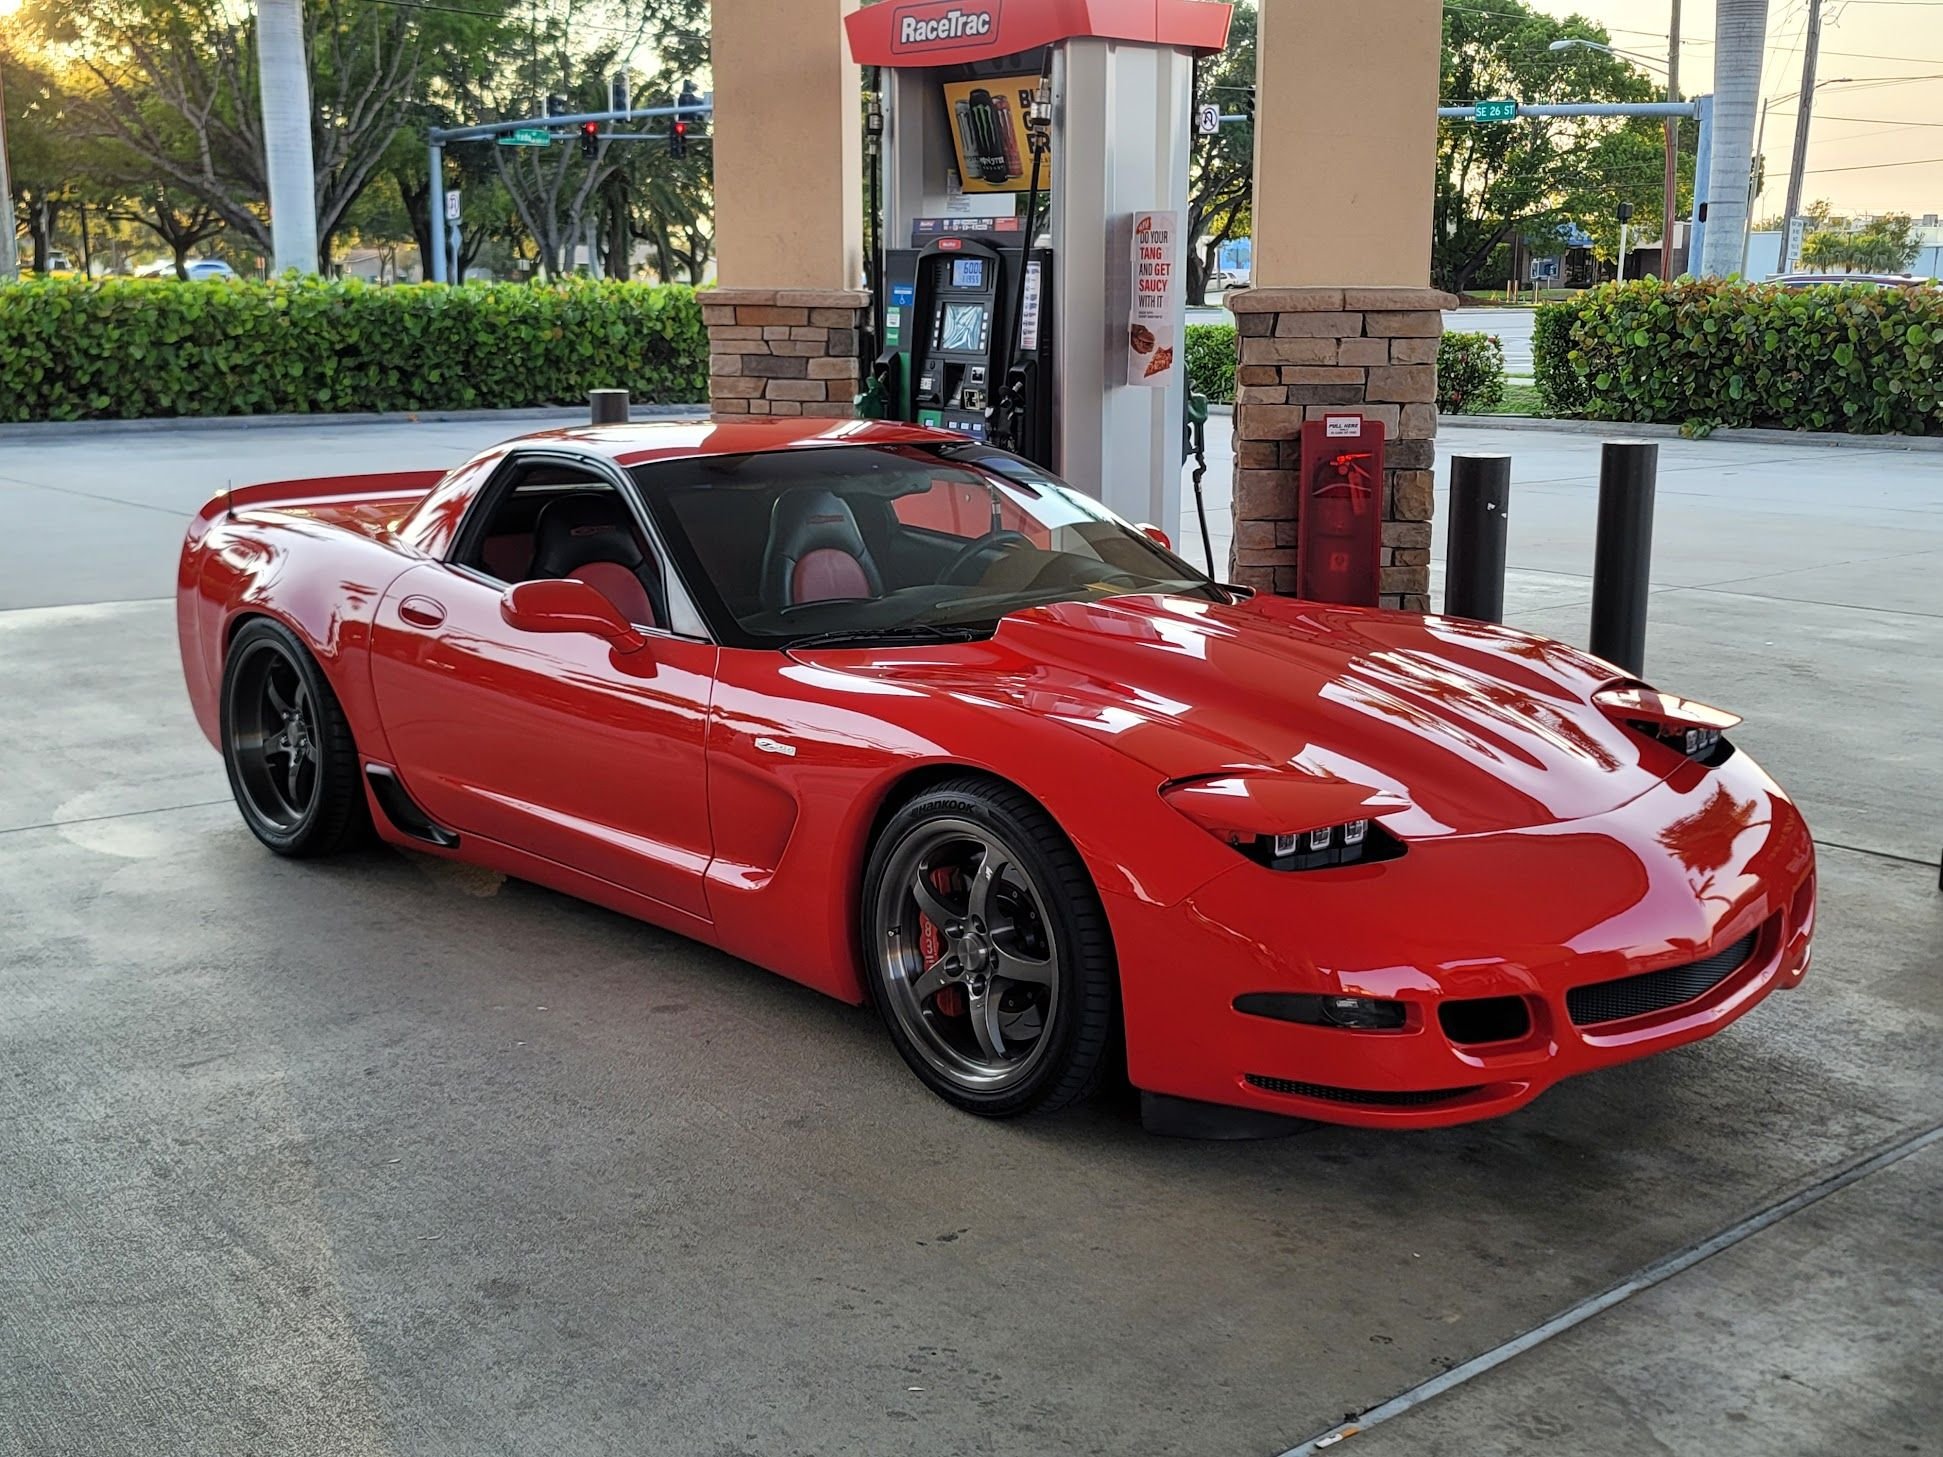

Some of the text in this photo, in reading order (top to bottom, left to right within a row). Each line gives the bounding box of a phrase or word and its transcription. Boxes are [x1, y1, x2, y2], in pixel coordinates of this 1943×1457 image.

[901, 11, 990, 43] RaceTrac
[1476, 105, 1513, 117] SE 26 ST
[1140, 230, 1168, 244] DO YOUR
[1140, 247, 1162, 260] TANG
[1139, 263, 1171, 276] AND GET
[1139, 279, 1168, 292] SAUCY
[1139, 295, 1163, 308] WITH IT
